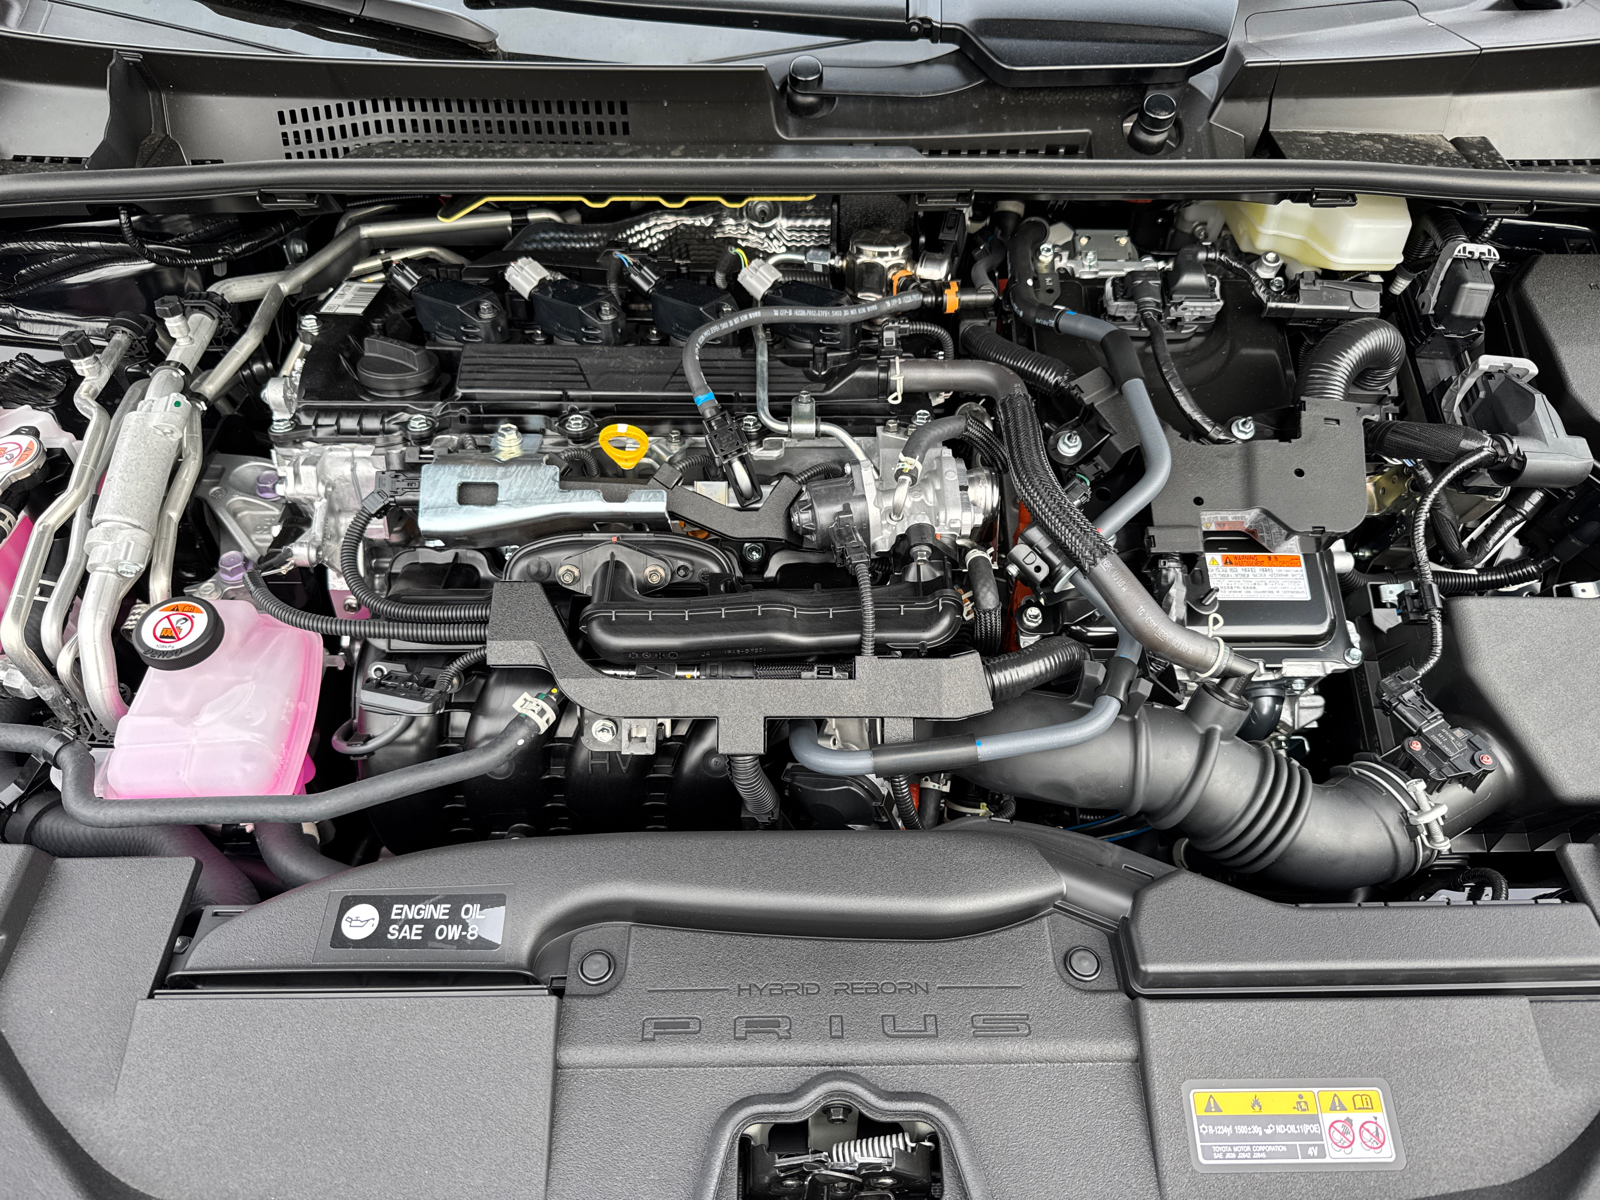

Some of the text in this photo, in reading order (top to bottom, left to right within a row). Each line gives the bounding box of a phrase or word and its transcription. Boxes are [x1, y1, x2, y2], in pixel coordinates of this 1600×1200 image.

[143, 648, 183, 659] DENSO
[588, 751, 633, 775] HV
[390, 903, 486, 920] ENGINE OIL
[387, 924, 422, 940] SAE
[736, 980, 931, 996] HYBRID REBORN
[640, 1013, 1032, 1042] PRIUS
[1252, 1145, 1287, 1153] CORPORATION
[1307, 1147, 1319, 1157] 4V
